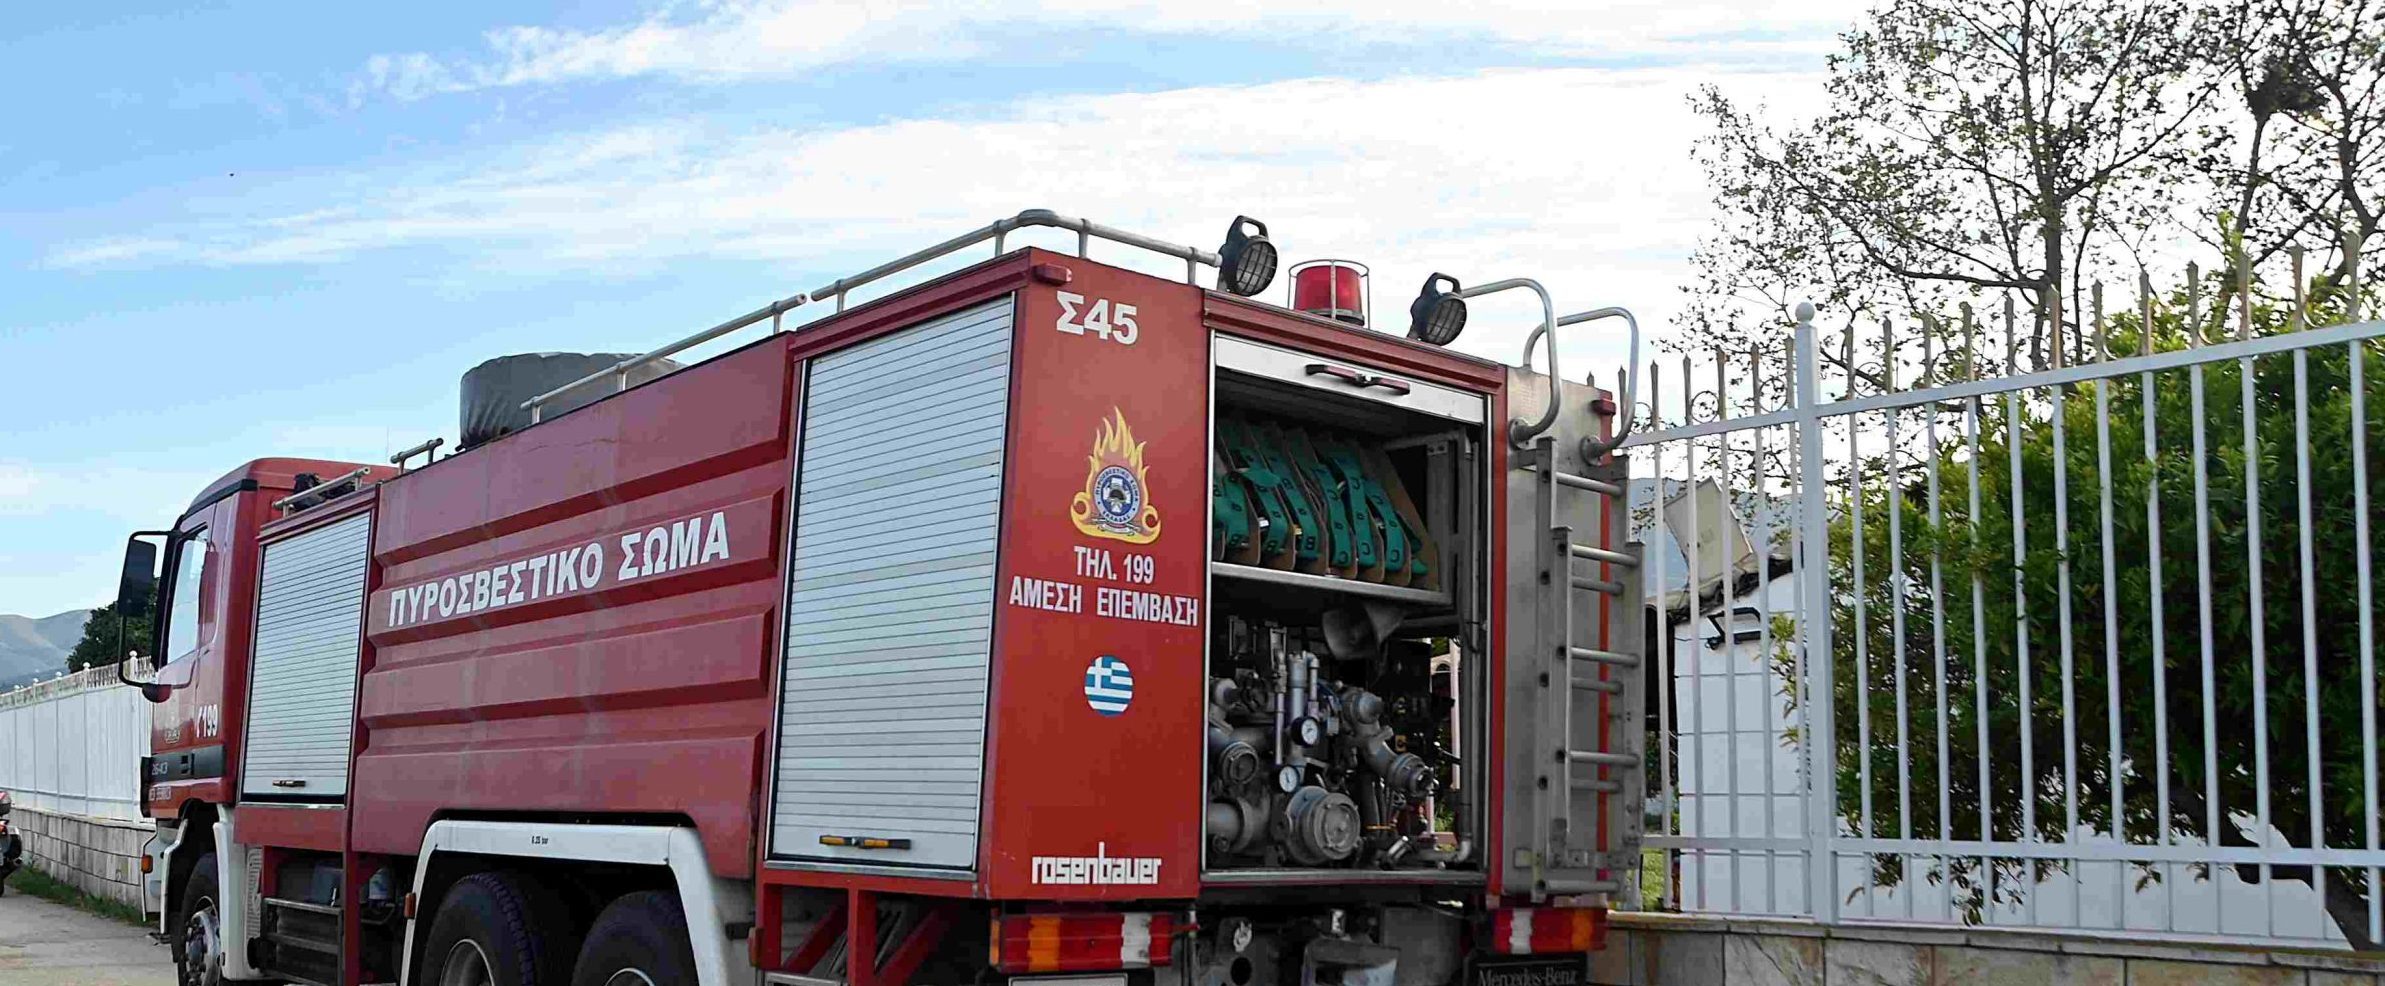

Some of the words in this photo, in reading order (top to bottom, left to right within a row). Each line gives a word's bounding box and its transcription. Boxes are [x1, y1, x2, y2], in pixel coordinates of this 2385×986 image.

[1056, 290, 1139, 345] Σ45
[388, 542, 603, 627] ΠΥΡΟΣΒΕΣΤΙΚΟ
[618, 511, 730, 581] ΣΩΜΑ
[1074, 546, 1117, 580] ΤΗΛ.
[1123, 554, 1154, 584] 199
[1009, 576, 1082, 613] ΑΜΕΣΗ
[1097, 587, 1198, 626] ΕΠΕΜΒΑΣΗ
[1031, 841, 1162, 884] rosenbauer
